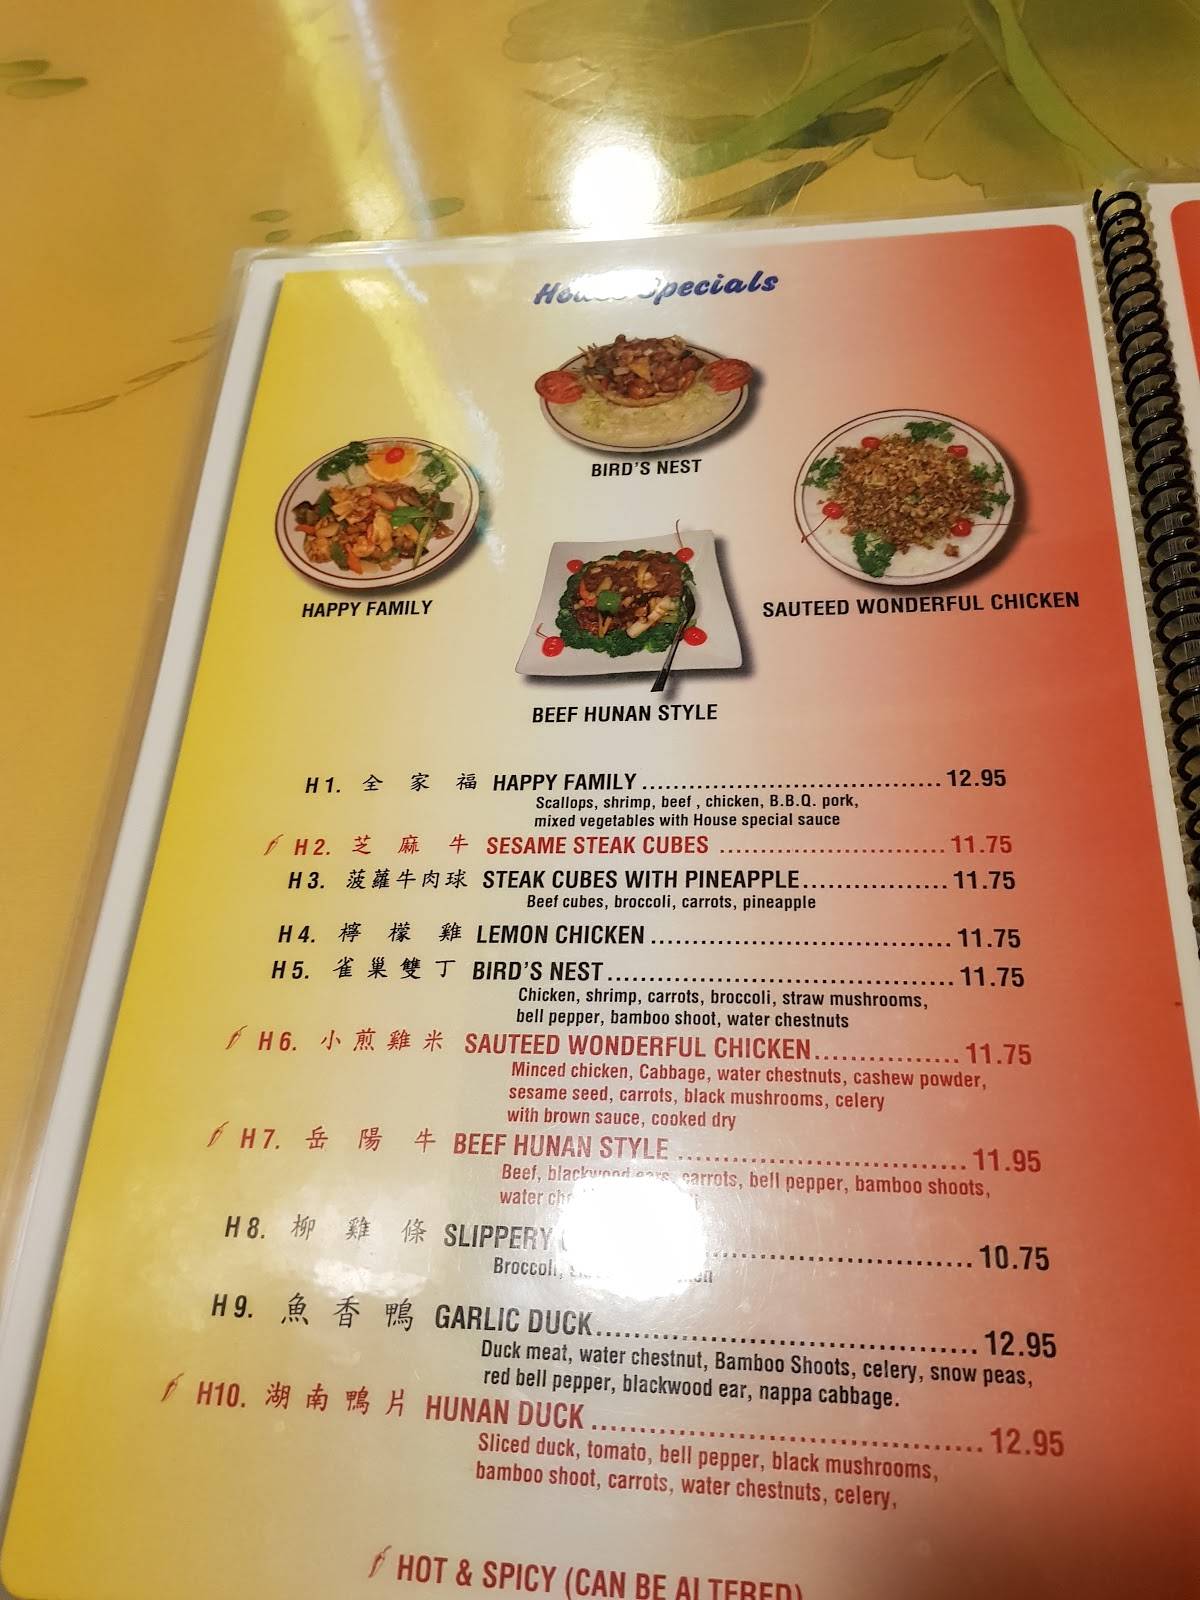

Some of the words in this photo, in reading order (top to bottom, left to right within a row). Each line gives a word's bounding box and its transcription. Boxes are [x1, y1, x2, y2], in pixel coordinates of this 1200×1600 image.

[657, 459, 702, 474] NEST
[301, 601, 361, 618] HAPPY
[365, 599, 433, 617] FAMILY
[762, 599, 849, 617] SAUTEED
[856, 595, 984, 614] WONDERFUL
[991, 591, 1080, 611] CHICKEN
[532, 707, 578, 723] BEEF
[584, 705, 651, 722] HUNAN
[658, 704, 718, 721] STYLE
[362, 772, 477, 792] 全家福
[493, 774, 558, 791] HAPPY
[564, 773, 637, 790] FAMILY
[946, 769, 1006, 787] 12.95
[536, 796, 598, 811] Scallops,
[604, 796, 655, 811] shrimp,
[706, 795, 764, 809] chicken,
[770, 794, 816, 807] B.B.Q.
[822, 794, 858, 809] pork,
[534, 814, 575, 827] mixed
[580, 814, 655, 829] vegetables
[659, 814, 688, 826] with
[694, 813, 737, 826] House
[742, 813, 793, 828] special
[798, 815, 840, 825] sauce
[352, 834, 469, 855] 芝麻牛
[487, 837, 567, 854] SESAME
[573, 836, 636, 854] STEAK
[643, 835, 708, 854] CUBES
[950, 835, 1012, 853] 11.75
[346, 866, 468, 889] 菠蘿牛肉球
[483, 870, 546, 888] STEAK
[552, 870, 617, 888] CUBES
[625, 870, 677, 888] WITH
[685, 870, 799, 888] PINEAPPLE
[953, 871, 1015, 890] 11.75
[527, 894, 559, 908] Beef
[563, 895, 608, 910] cubes,
[614, 894, 676, 910] broccoli,
[682, 895, 736, 910] carrots,
[743, 895, 816, 911] pineapple
[338, 921, 462, 943] 檸檬雞
[477, 925, 548, 944] LEMON
[556, 925, 644, 944] CHICKEN
[957, 928, 1021, 948] 11.75
[332, 956, 456, 979] 雀巢雙丁
[550, 962, 603, 981] NEST
[960, 966, 1024, 987] 11.75
[519, 987, 580, 1004] Chicken,
[586, 988, 641, 1006] shrimp,
[648, 990, 704, 1006] carrots,
[711, 989, 776, 1008] broccoli,
[782, 991, 824, 1005] straw
[830, 992, 927, 1010] mushrooms,
[516, 1008, 544, 1023] bell
[548, 1012, 604, 1027] pepper,
[610, 1010, 670, 1025] bamboo
[675, 1010, 721, 1028] shoot,
[727, 1012, 771, 1026] water
[775, 1012, 849, 1028] chestnuts
[321, 1027, 443, 1052] 小煎雞米
[465, 1033, 560, 1054] SAUTEED
[568, 1035, 706, 1057] WONDERFUL
[714, 1037, 810, 1060] CHICKEN
[966, 1043, 1031, 1065] 11.75
[512, 1061, 566, 1077] Minced
[571, 1063, 633, 1081] chicken,
[640, 1064, 711, 1084] Cabbage,
[717, 1067, 761, 1081] water
[766, 1067, 847, 1086] chestnuts,
[854, 1069, 914, 1085] cashew
[920, 1071, 986, 1090] powder,
[509, 1087, 567, 1100] sesame
[572, 1086, 613, 1104] seed,
[620, 1088, 677, 1105] carrots,
[685, 1088, 725, 1104] black
[731, 1089, 828, 1110] mushrooms,
[836, 1092, 885, 1112] celery
[508, 1107, 538, 1122] with
[544, 1107, 590, 1124] brown
[595, 1112, 644, 1128] sauce,
[652, 1111, 706, 1127] cooked
[712, 1112, 736, 1131] dry
[305, 1126, 436, 1152] 岳陽牛
[453, 1133, 507, 1155] BEEF
[514, 1134, 591, 1157] HUNAN
[600, 1136, 668, 1160] STYLE
[973, 1148, 1041, 1173] 11.95
[502, 1164, 541, 1183] Beef,
[682, 1172, 744, 1190] carrots,
[749, 1172, 780, 1188] bell
[786, 1175, 849, 1195] pepper,
[856, 1175, 922, 1194] bamboo
[928, 1178, 990, 1199] shoots,
[500, 1189, 543, 1205] water
[291, 1214, 427, 1243] 柳雞條
[444, 1224, 552, 1250] SLIPPERY
[979, 1245, 1049, 1271] 10.75
[281, 1292, 413, 1332] 魚香鴨
[435, 1304, 520, 1332] GARLIC
[528, 1309, 593, 1336] DUCK
[984, 1330, 1057, 1359] 12.95
[481, 1340, 521, 1359] Duck
[526, 1344, 572, 1365] meat,
[579, 1346, 626, 1364] water
[631, 1348, 708, 1372] chestnut,
[715, 1351, 785, 1372] Bamboo
[791, 1355, 856, 1380] Shoots,
[862, 1360, 924, 1384] celery,
[929, 1366, 977, 1382] snow
[983, 1368, 1032, 1388] peas,
[197, 1381, 245, 1408] H10.
[265, 1381, 404, 1417] 湖南鴨片
[484, 1367, 511, 1385] red
[516, 1368, 547, 1387] bell
[552, 1374, 615, 1394] pepper,
[623, 1374, 712, 1396] blackwood
[719, 1383, 752, 1402] ear,
[759, 1385, 812, 1405] nappa
[818, 1385, 899, 1410] cabbage.
[426, 1395, 509, 1424] HUNAN
[518, 1401, 584, 1429] DUCK
[990, 1427, 1064, 1457] 12.95
[478, 1432, 530, 1454] Sliced
[536, 1437, 580, 1460] duck,
[587, 1440, 652, 1465] tomato,
[660, 1444, 692, 1464] bell
[698, 1451, 764, 1472] pepper,
[772, 1450, 819, 1472] black
[825, 1456, 938, 1483] mushrooms,
[476, 1461, 543, 1483] bamboo
[549, 1466, 600, 1490] shoot,
[608, 1473, 673, 1495] carrots,
[681, 1476, 731, 1495] water
[736, 1478, 827, 1505] chestnuts,
[835, 1485, 896, 1511] celery,
[397, 1554, 448, 1584] HOT
[456, 1559, 472, 1586] &
[482, 1561, 557, 1592] SPICY
[565, 1567, 626, 1600] (CAN
[636, 1573, 667, 1600] BE
